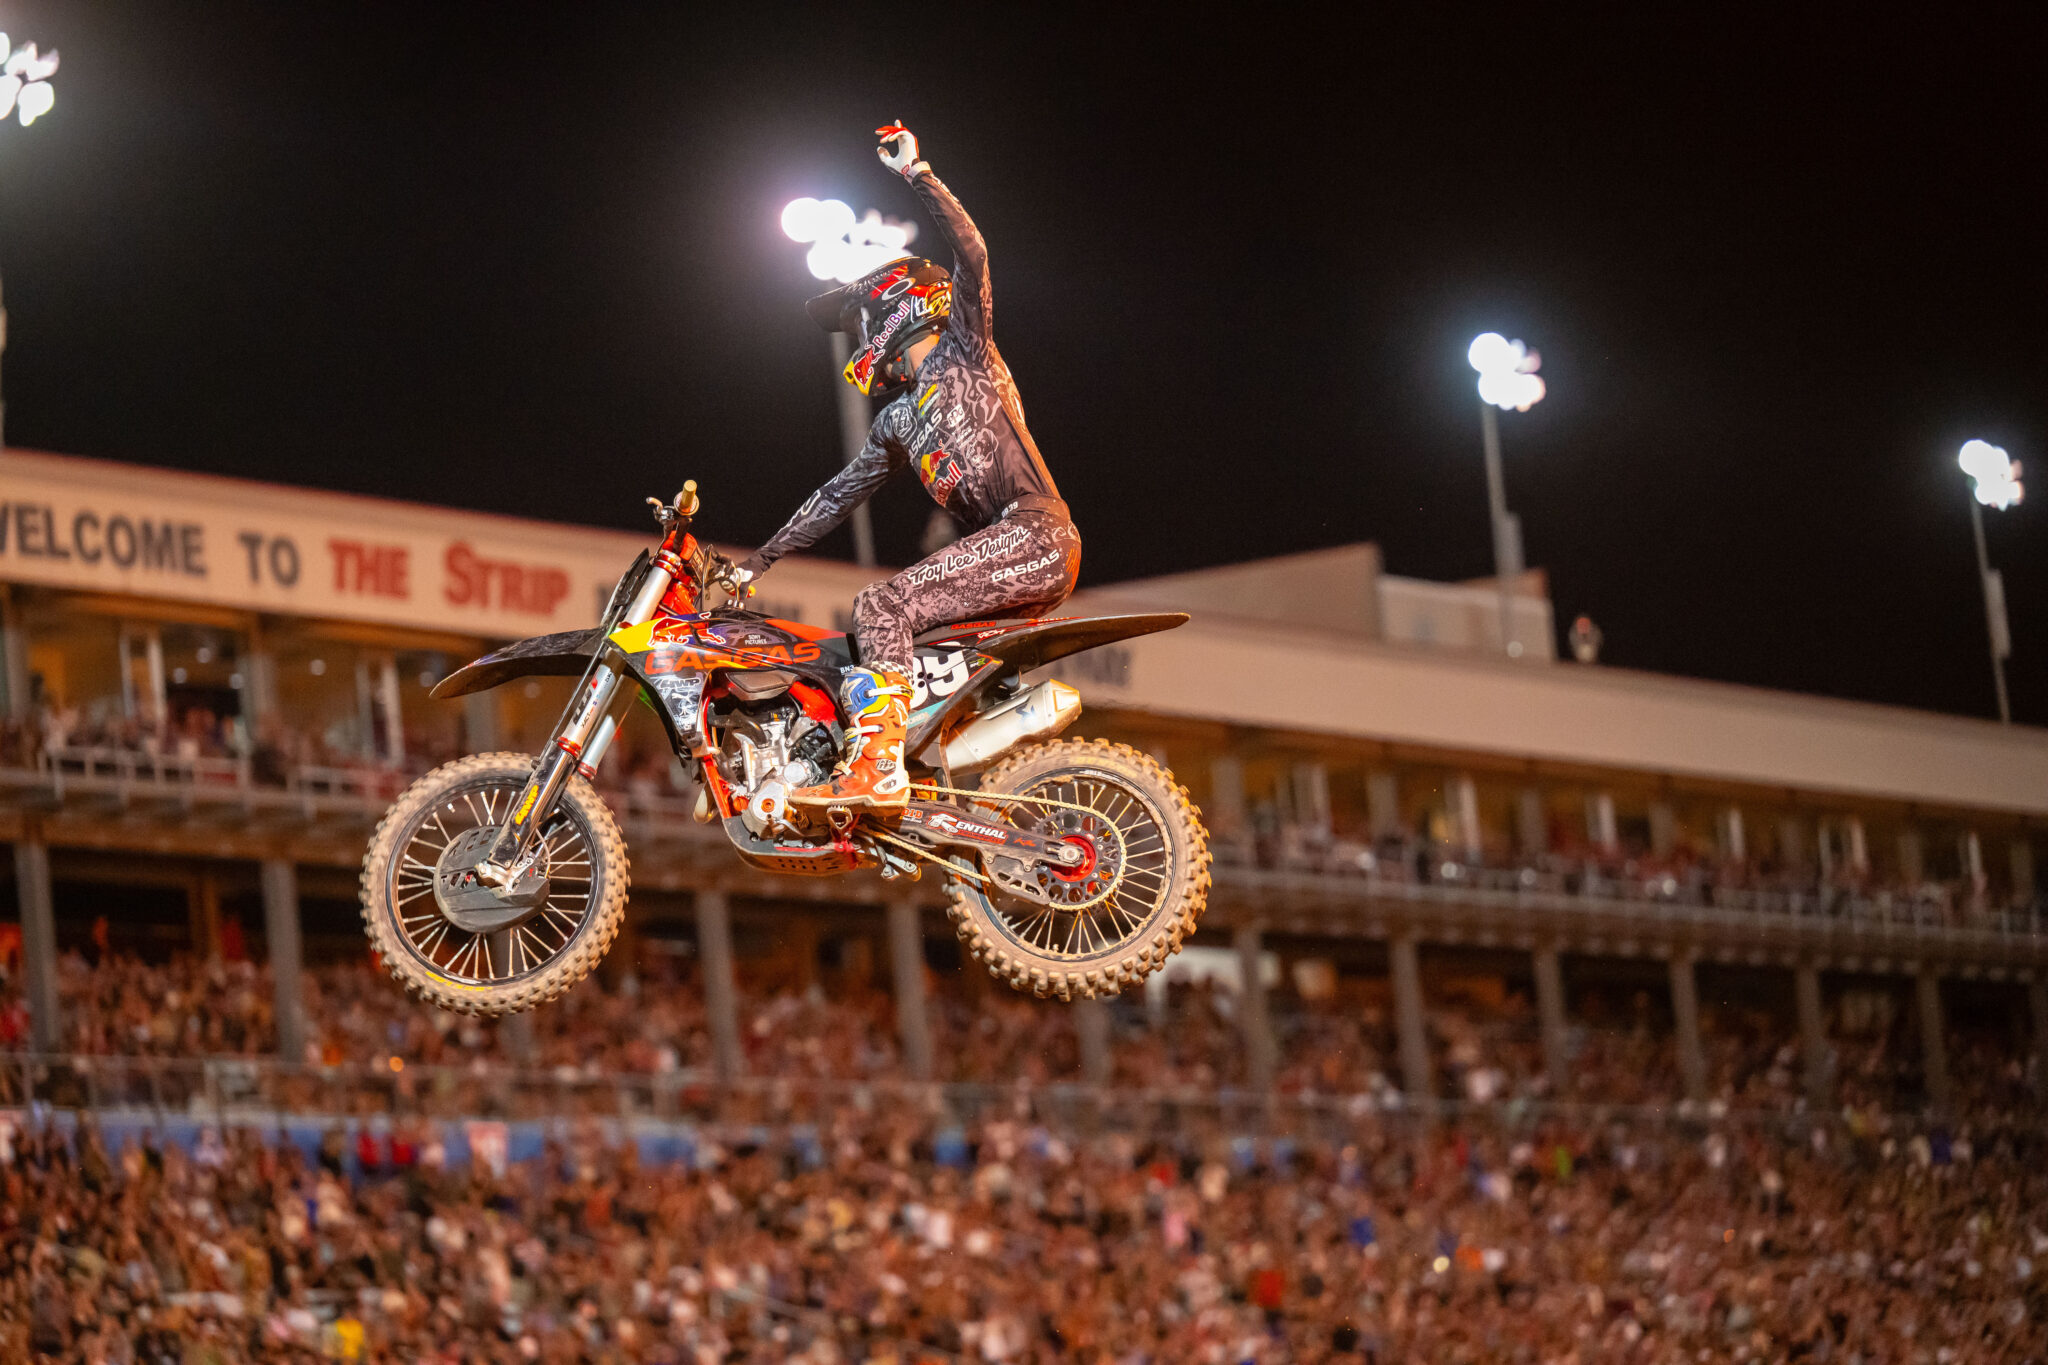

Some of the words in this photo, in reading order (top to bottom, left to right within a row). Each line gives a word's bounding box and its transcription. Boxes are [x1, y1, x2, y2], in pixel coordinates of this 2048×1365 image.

[908, 408, 942, 466] ASGAS
[238, 531, 299, 588] TO
[327, 538, 410, 602] THE
[443, 540, 571, 618] STRIP
[908, 562, 945, 586] Troy
[945, 553, 976, 574] Lee
[973, 526, 1031, 562] Designs
[992, 550, 1060, 582] GASGAS
[644, 642, 821, 675] GASGAS
[927, 812, 1007, 840] RENTHAL
